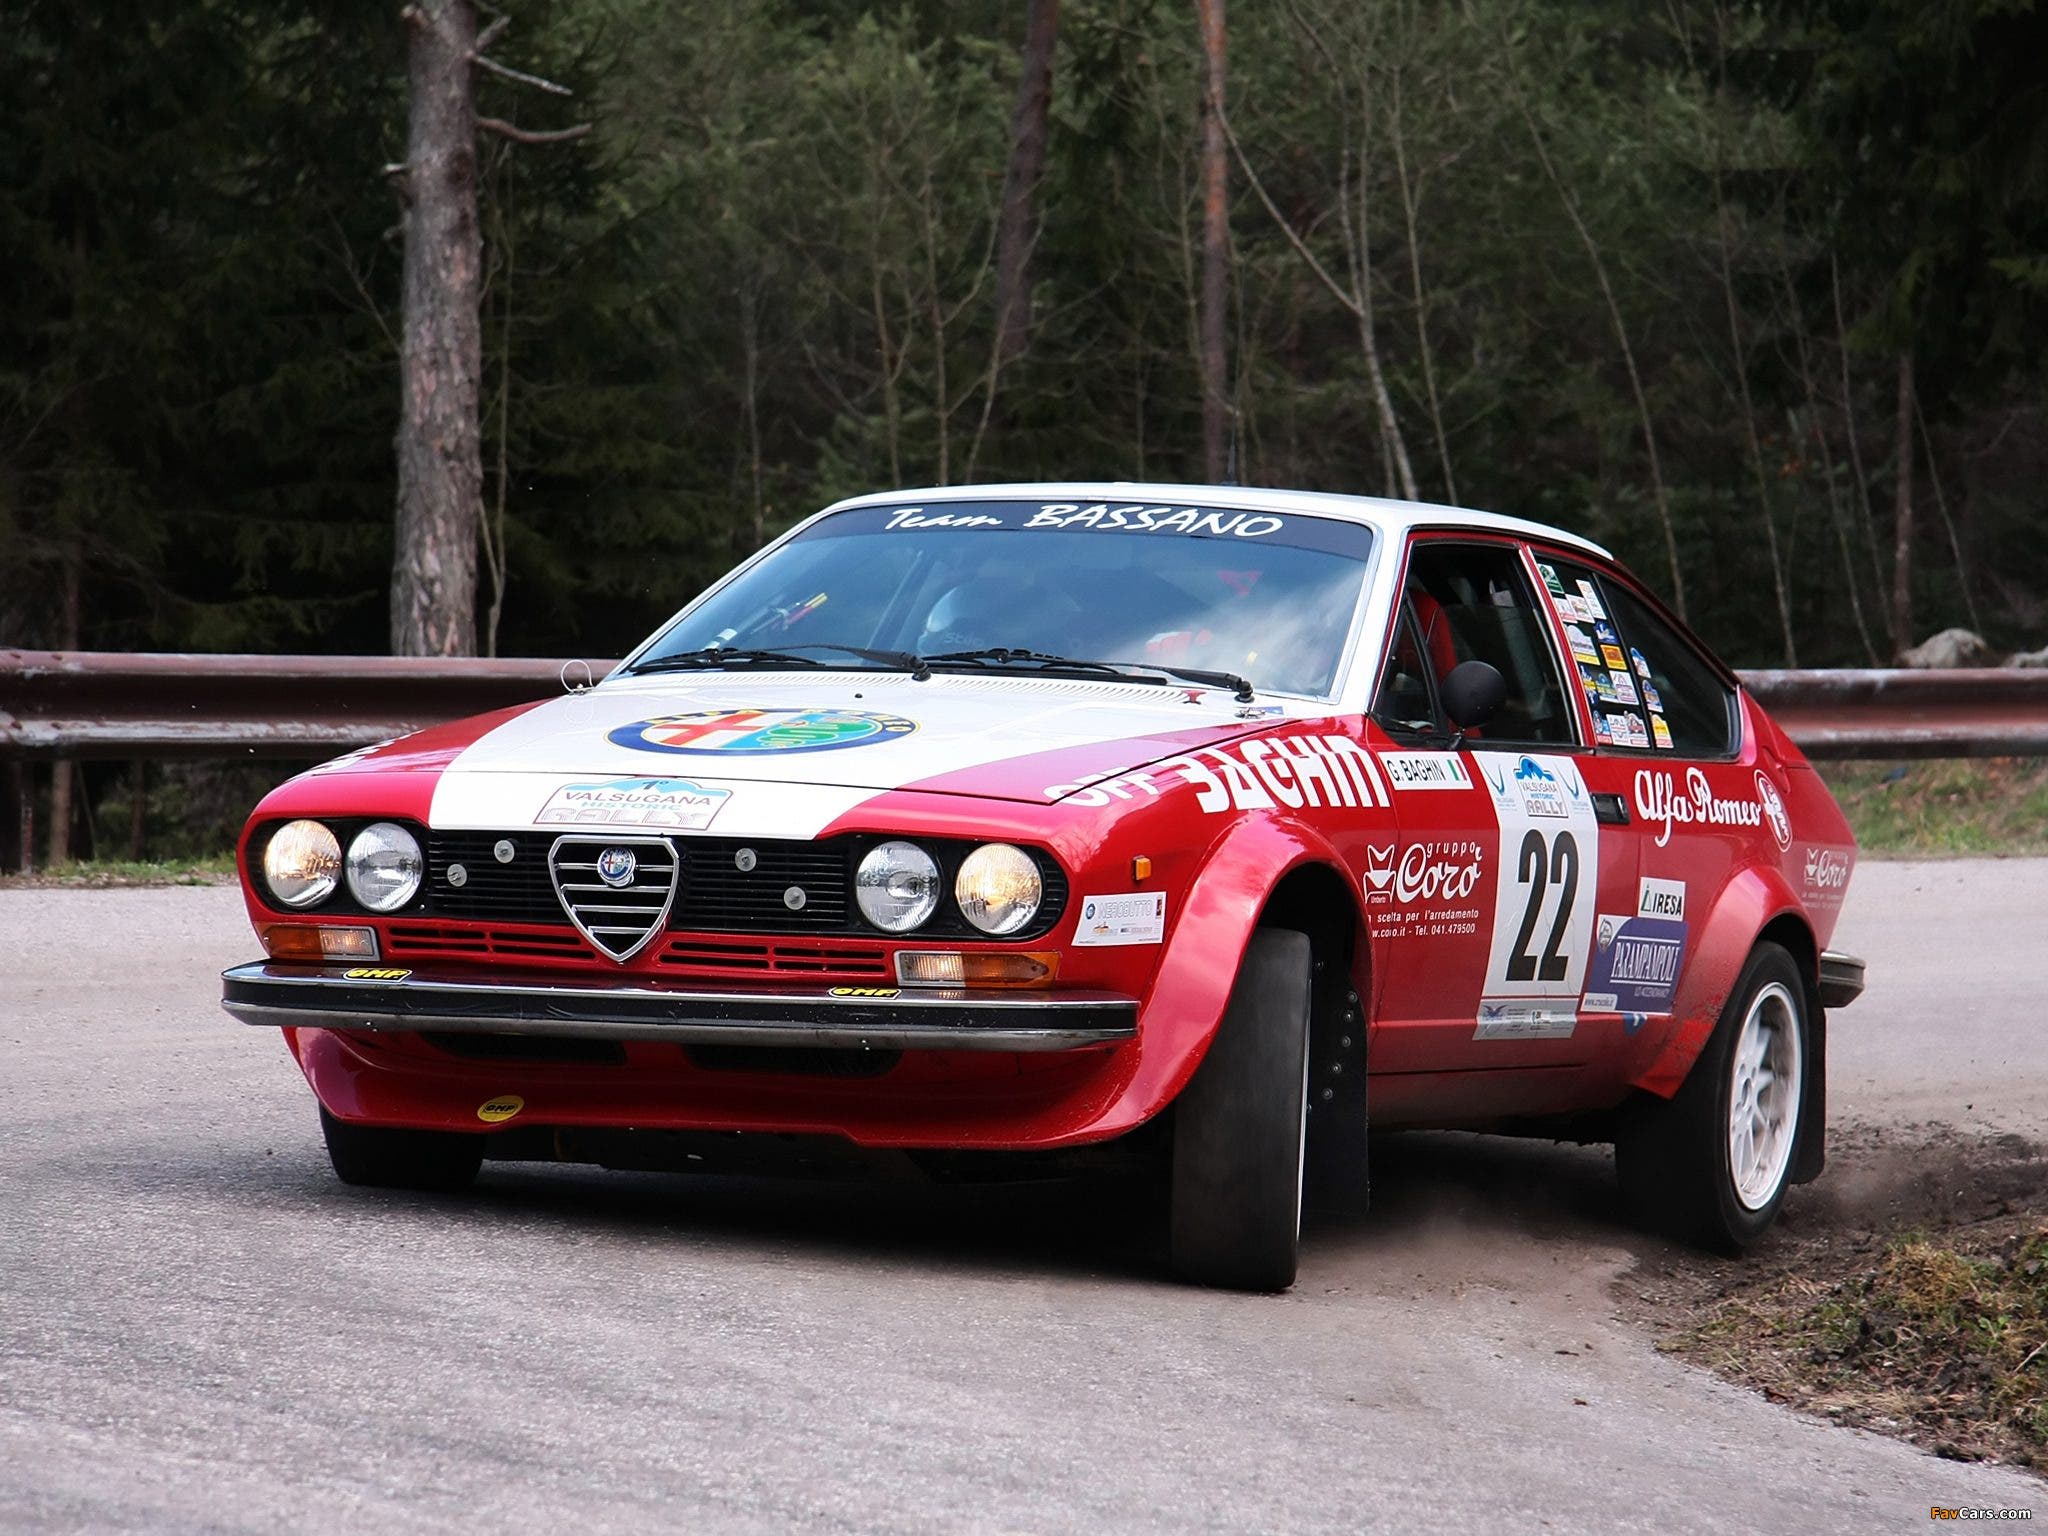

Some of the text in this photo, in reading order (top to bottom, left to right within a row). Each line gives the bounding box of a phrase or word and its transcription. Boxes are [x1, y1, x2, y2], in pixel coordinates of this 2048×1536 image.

[884, 504, 1283, 537] Team BASSANO
[1386, 759, 1447, 781] G. BAGHIN
[566, 792, 712, 806] VALSUGANA
[580, 801, 682, 811] HISTORIC
[1526, 799, 1564, 815] RALLY
[1634, 769, 1694, 848] Alfa
[1686, 766, 1761, 826] Romeo
[541, 807, 708, 826] RALLY
[1427, 841, 1476, 858] gruppo
[1505, 828, 1579, 981] 22
[1652, 892, 1683, 916] IRESA
[1377, 911, 1401, 923] scelta
[1405, 912, 1420, 923] per
[1424, 908, 1479, 921] l'arredamento
[1415, 925, 1429, 936] Tel.
[1431, 923, 1476, 935] 041.479500
